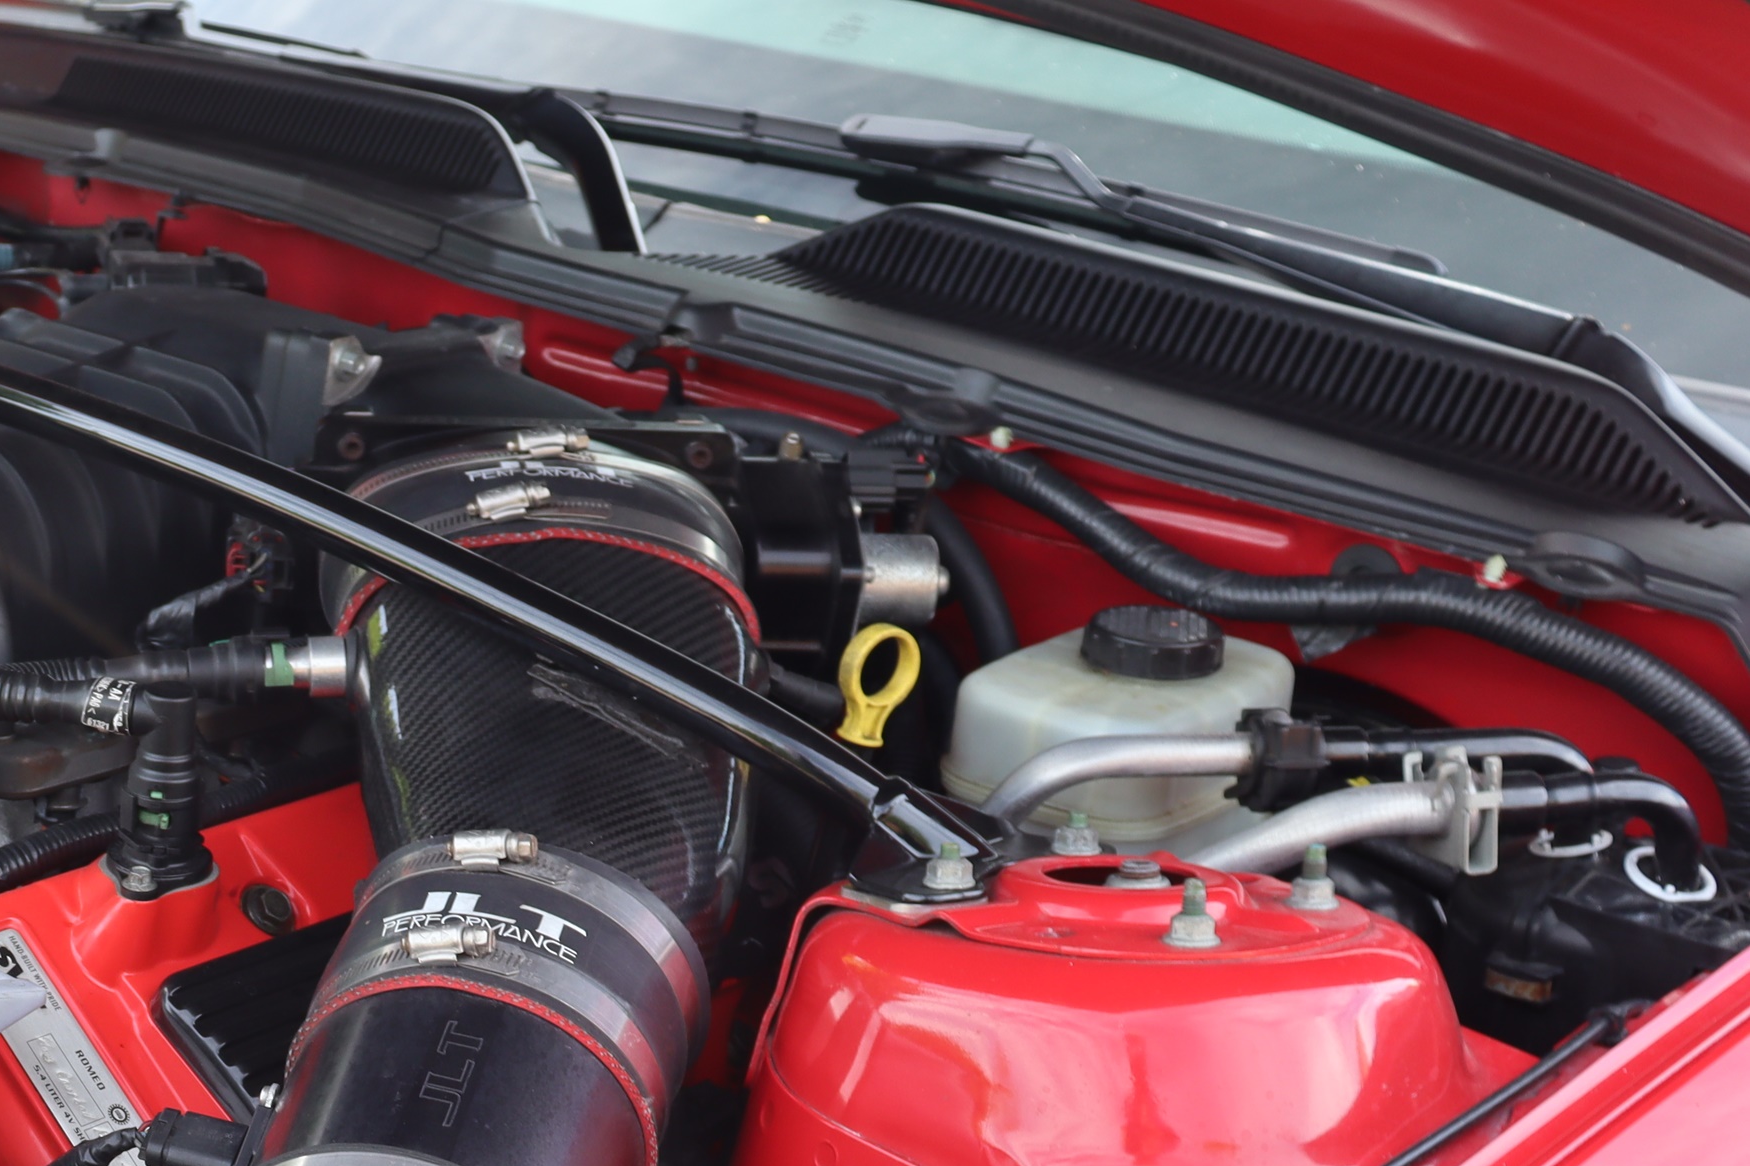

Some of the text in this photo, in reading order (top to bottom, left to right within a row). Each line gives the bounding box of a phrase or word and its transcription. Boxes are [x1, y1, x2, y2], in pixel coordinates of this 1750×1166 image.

[382, 891, 587, 942] JLT
[8, 935, 37, 974] HAND-BUILT
[45, 991, 62, 1012] PRIDE
[33, 1064, 47, 1081] 5.4
[44, 1082, 65, 1109] LITER
[63, 1110, 76, 1125] 4V
[75, 1049, 106, 1091] ROMEO
[419, 1019, 484, 1128] JLT
